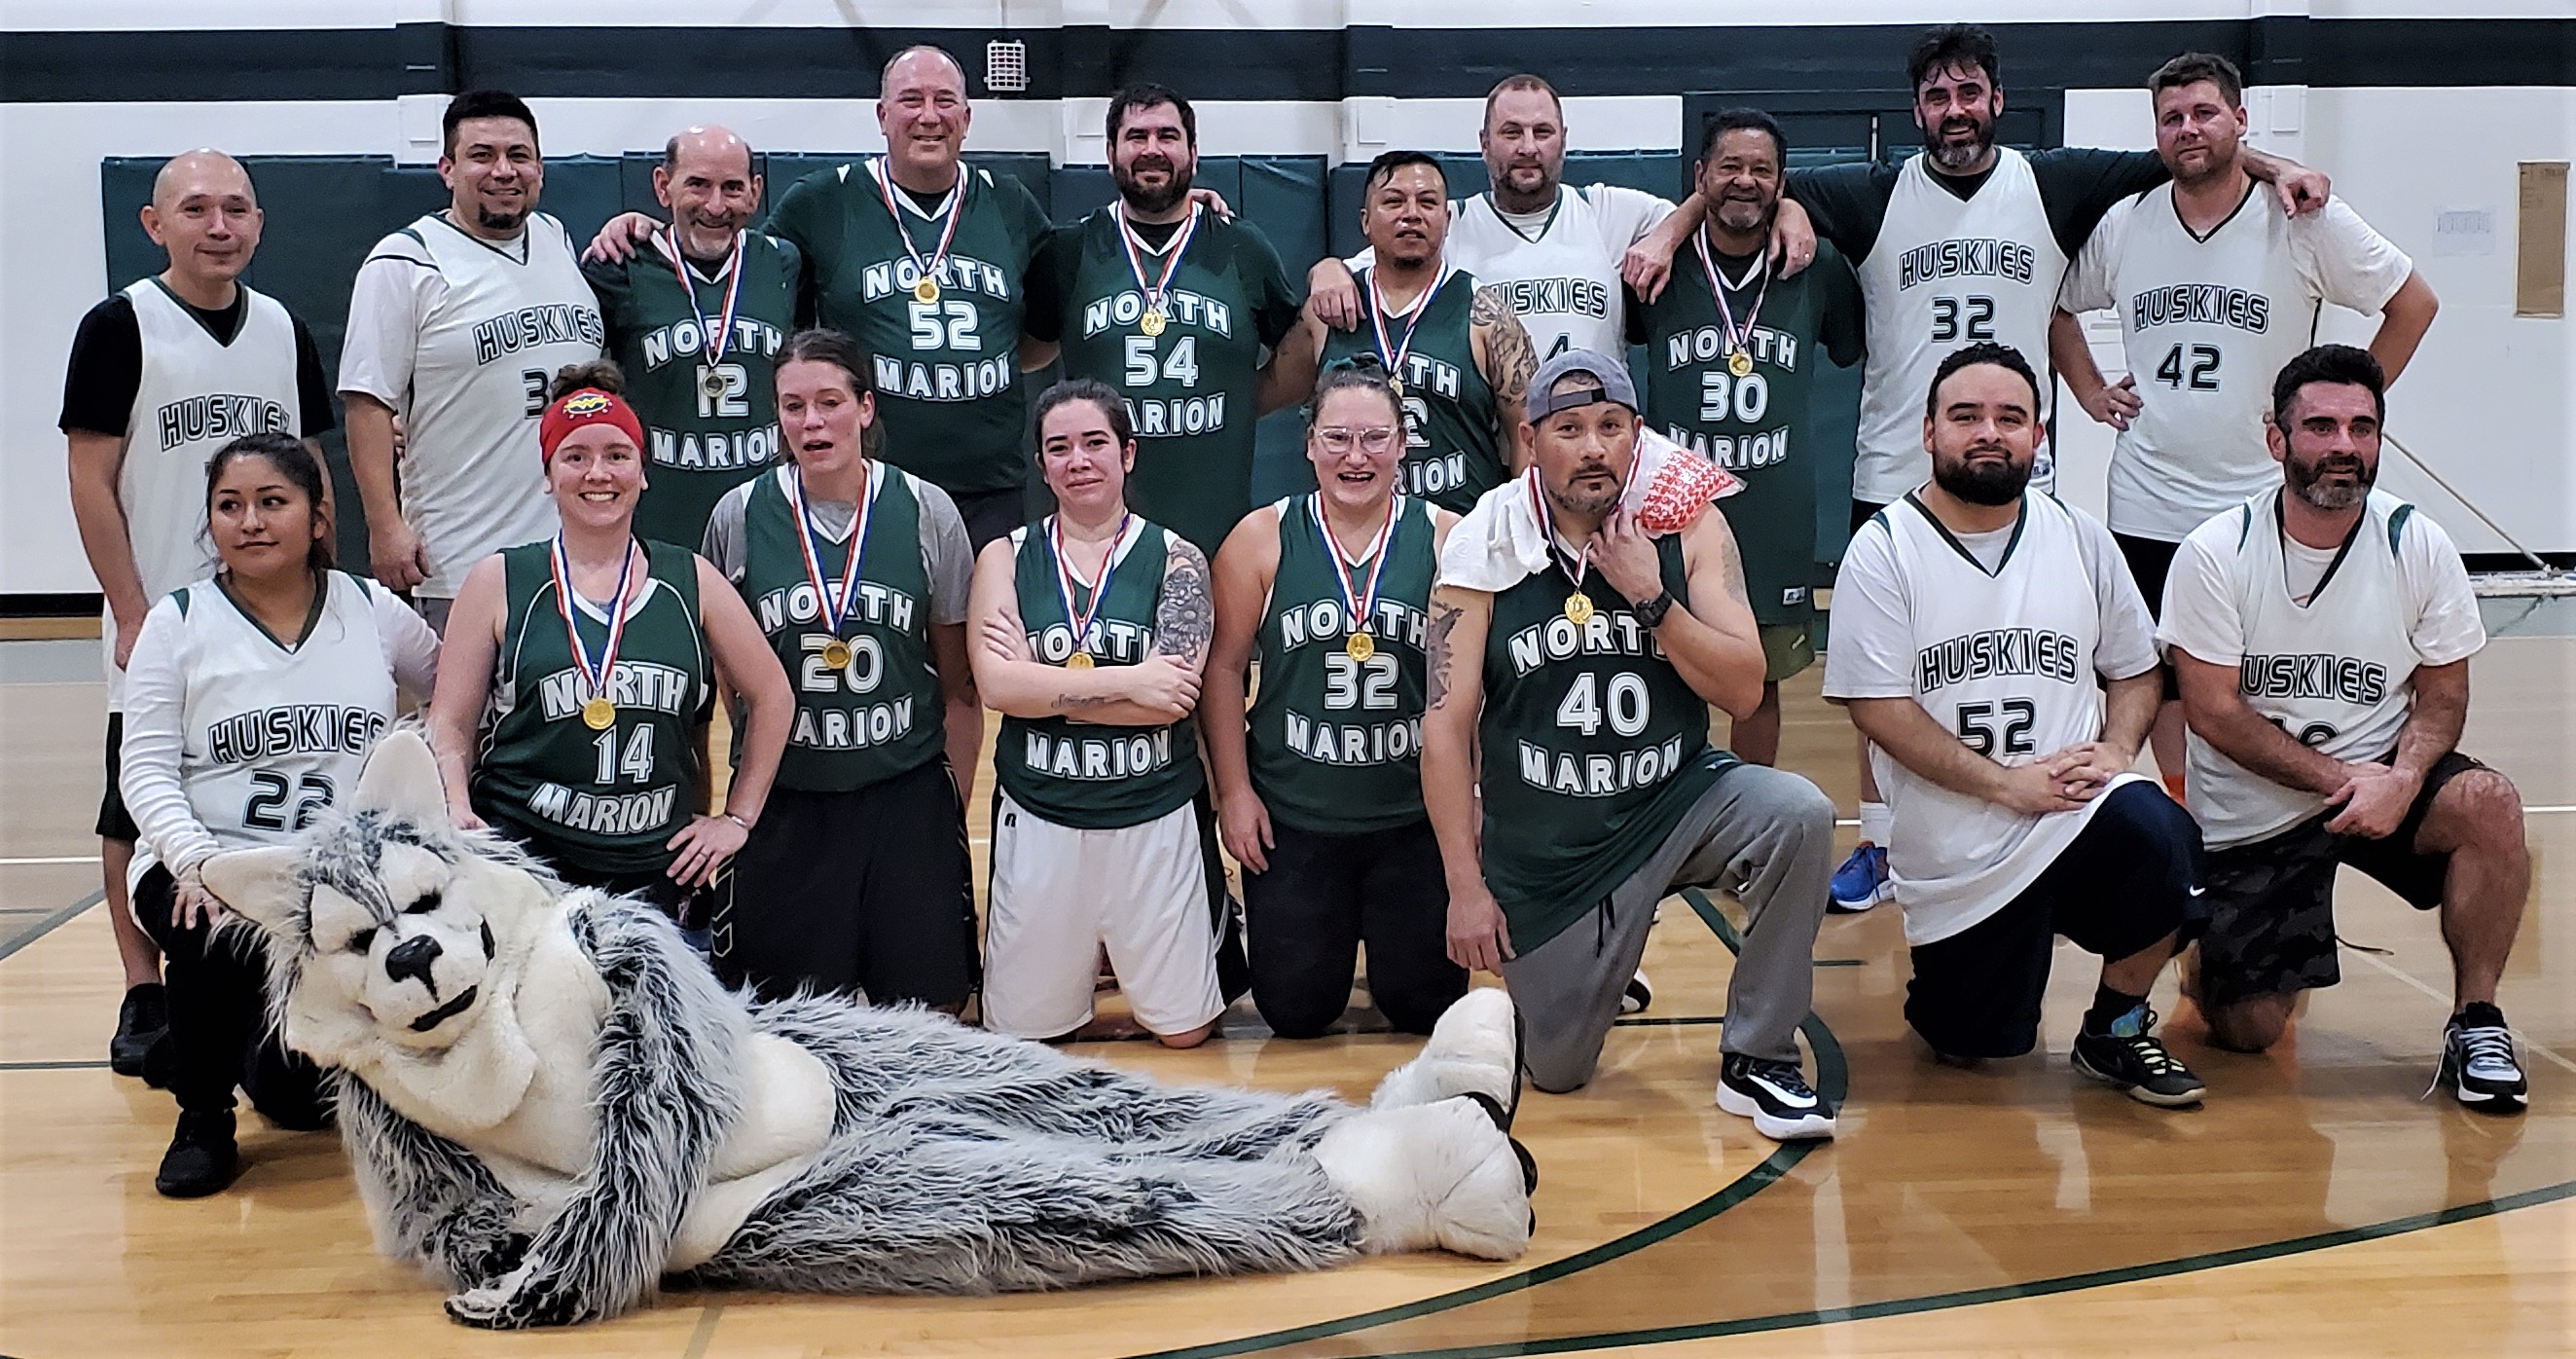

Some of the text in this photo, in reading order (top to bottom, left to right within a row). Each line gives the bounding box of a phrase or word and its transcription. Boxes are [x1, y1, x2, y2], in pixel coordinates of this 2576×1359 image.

[862, 253, 1009, 304] NORTH
[1900, 238, 2035, 291] HUSKIES
[908, 300, 981, 350] 52
[1083, 287, 1231, 340] NORTH
[1491, 277, 1608, 319] USKIES
[1932, 295, 1996, 343] 32
[2133, 284, 2268, 334] HUSKIES
[472, 304, 603, 366] HUSKIES
[641, 314, 783, 373] NORTH
[1125, 335, 1198, 386] 54
[1668, 323, 1798, 373] NORTH
[522, 368, 551, 420] 3
[696, 363, 749, 418] 12
[873, 351, 1011, 402] MARION
[2155, 343, 2222, 391] 42
[158, 393, 290, 452] HUSKIE
[1122, 391, 1225, 437] RION
[1700, 371, 1767, 422] 30
[650, 421, 780, 470] MARION
[1669, 422, 1789, 470] MARION
[1393, 451, 1468, 497] RION
[758, 578, 915, 637] NORTH
[1281, 596, 1428, 653] NORTH
[800, 634, 884, 693] 20
[1508, 610, 1671, 679] NORT
[1918, 628, 2079, 694] HUSKIES
[539, 661, 689, 722] NORTH
[1324, 652, 1398, 709] 32
[1557, 672, 1650, 737] 40
[2239, 653, 2387, 706] USKIES
[789, 692, 913, 751] ARION
[1286, 708, 1426, 766] MARION
[1956, 697, 2037, 757] 52
[593, 723, 654, 784] 14
[1026, 723, 1172, 781] MARION
[1518, 732, 1683, 797] MARION
[242, 768, 338, 832] 22
[526, 783, 677, 834] MARION
